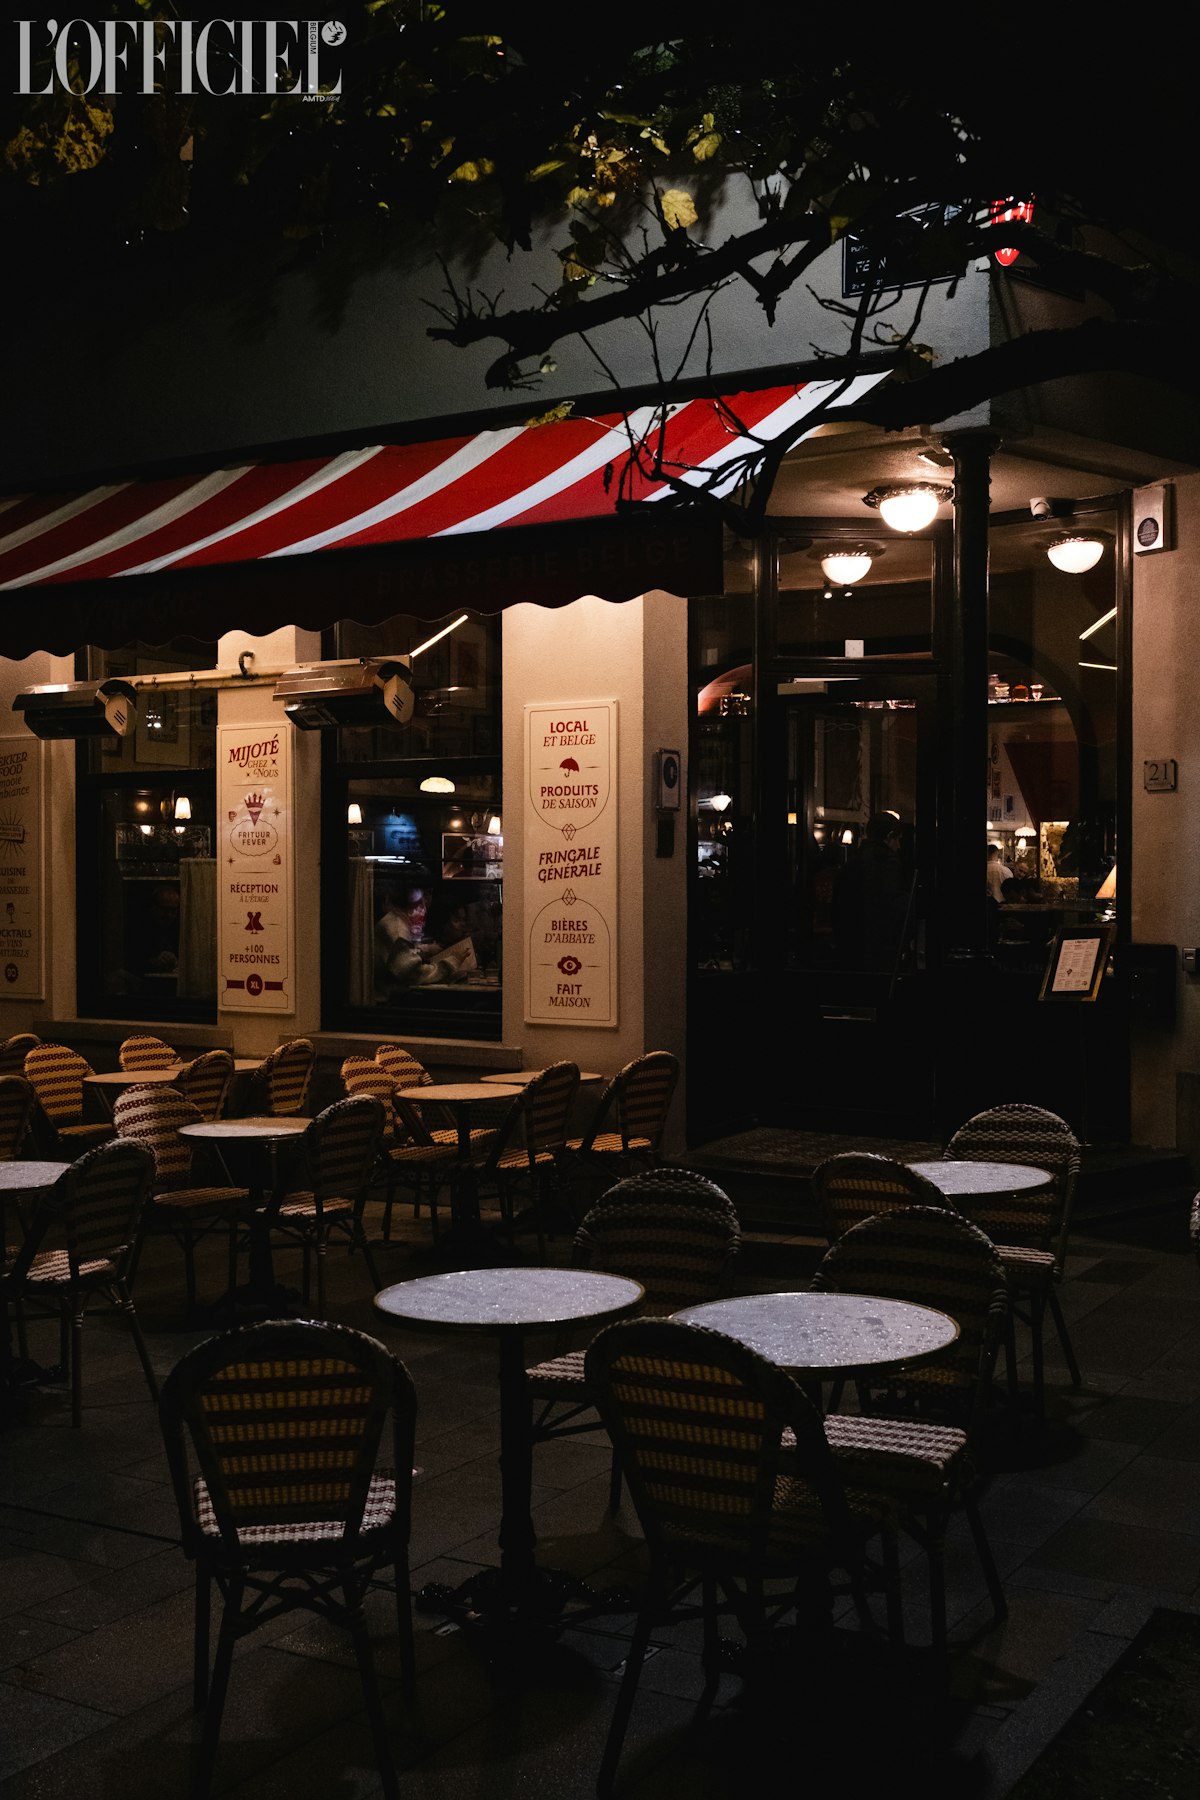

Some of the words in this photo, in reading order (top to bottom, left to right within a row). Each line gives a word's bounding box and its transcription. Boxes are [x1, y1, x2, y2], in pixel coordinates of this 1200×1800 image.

[375, 551, 560, 596] BRASSERIE
[576, 535, 691, 574] BELGE
[550, 720, 589, 734] LOCAL
[543, 735, 558, 748] ET
[559, 733, 596, 747] BELGE
[228, 734, 280, 768] MIJOTÉ
[0, 751, 28, 766] EKKER
[247, 759, 269, 770] CHEZ
[253, 768, 279, 779] NOUS
[1149, 763, 1168, 781] 21
[540, 783, 600, 798] PRODUITS
[541, 798, 557, 810] DE
[558, 797, 598, 810] SAISON
[238, 830, 271, 840] FRITUUR
[242, 838, 267, 848] FEVER
[538, 846, 601, 866] FRINGALE
[0, 867, 27, 877] UISINE
[537, 862, 602, 884] GÉNÉRALE
[230, 880, 279, 895] RÉCEPTION
[551, 917, 588, 932] BIÈRES
[0, 929, 32, 939] CKTAILS
[544, 931, 596, 945] D'ABBAYE
[244, 943, 265, 955] +100
[229, 953, 281, 966] PERSONNES
[556, 983, 583, 996] FAIT
[548, 995, 591, 1009] MAISON
